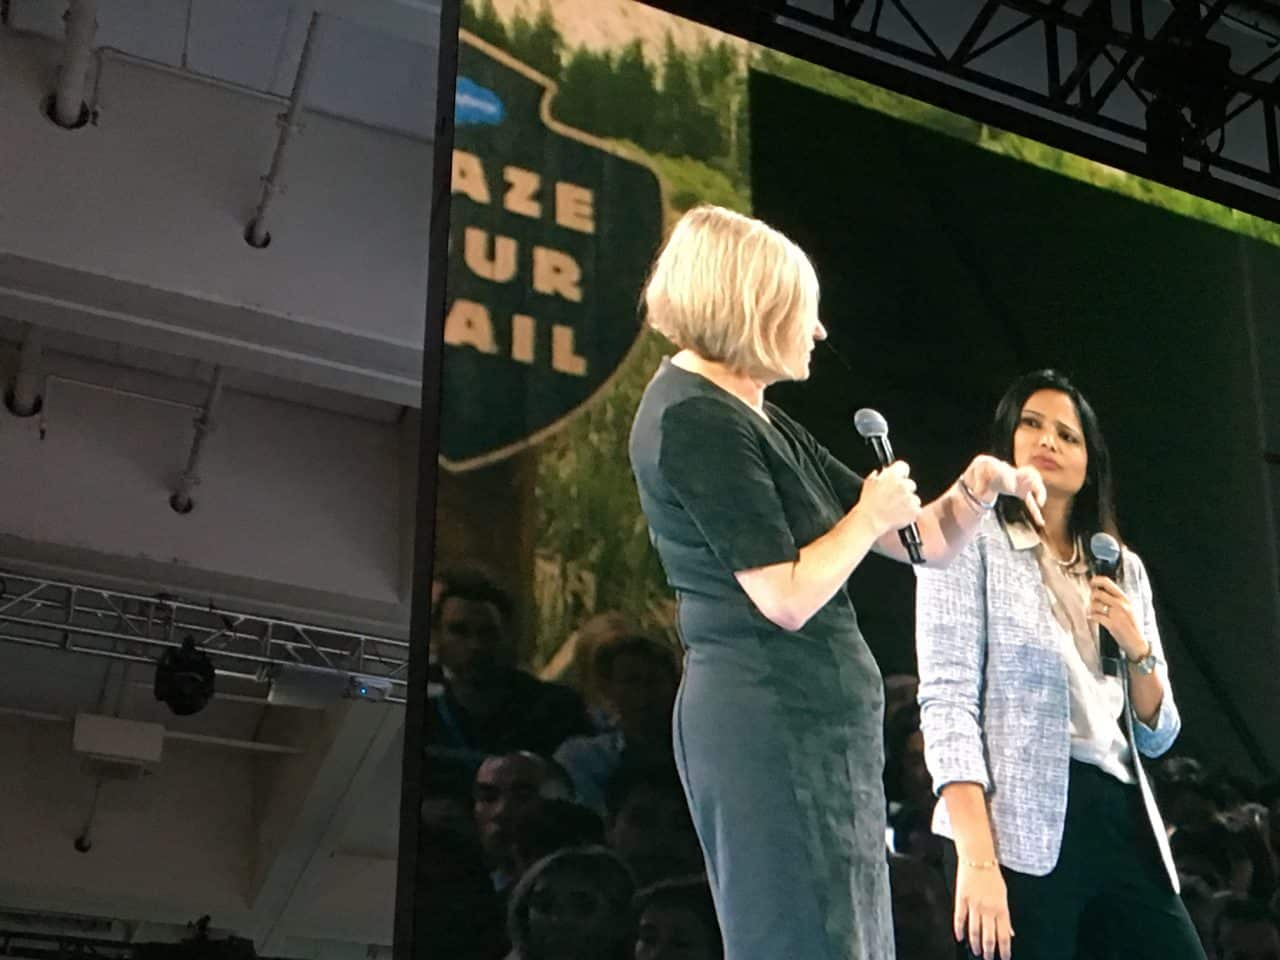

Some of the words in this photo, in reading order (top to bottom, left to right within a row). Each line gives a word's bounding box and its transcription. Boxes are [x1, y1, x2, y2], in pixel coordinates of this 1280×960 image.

[451, 149, 595, 234] AZE
[464, 226, 583, 303] UR
[444, 299, 588, 376] AIL
